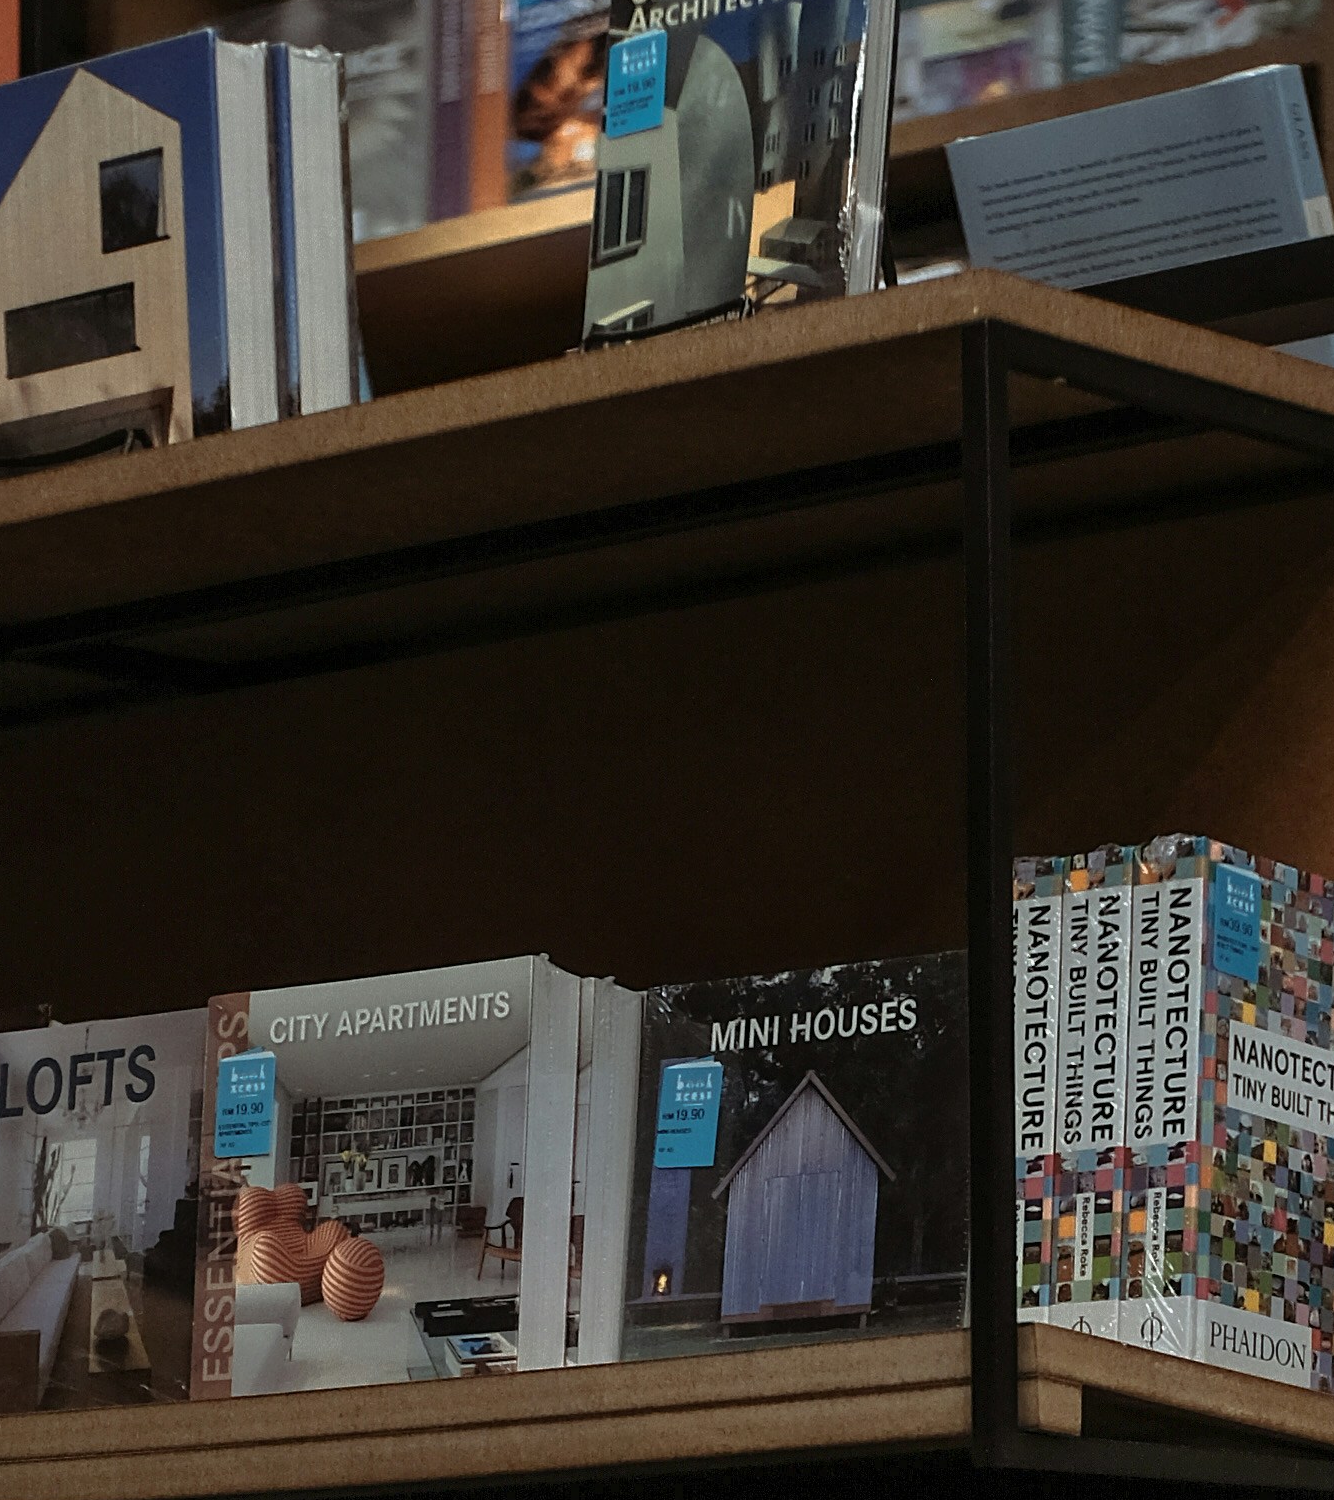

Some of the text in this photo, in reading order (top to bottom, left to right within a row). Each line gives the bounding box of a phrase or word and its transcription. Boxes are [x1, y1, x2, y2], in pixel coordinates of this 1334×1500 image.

[0, 1043, 156, 1119] LOFTS
[269, 990, 511, 1045] CITY APARTMENTS
[710, 998, 918, 1052] MINI HOUSES
[1021, 903, 1051, 1151] NANOTECTURE
[1063, 899, 1090, 1146] TINY BUILT THINGS
[1091, 894, 1122, 1142] NANOTECTURE
[1133, 891, 1160, 1140] TINY BUILT THINGS
[1162, 886, 1193, 1139] NANOTECTURE
[1233, 1073, 1267, 1106] TINY
[1270, 1084, 1315, 1120] BUILT
[202, 1156, 245, 1382] ESSENTIA
[1078, 1195, 1092, 1278] Rebecca Roke
[1209, 1320, 1307, 1370] PHAIDON
